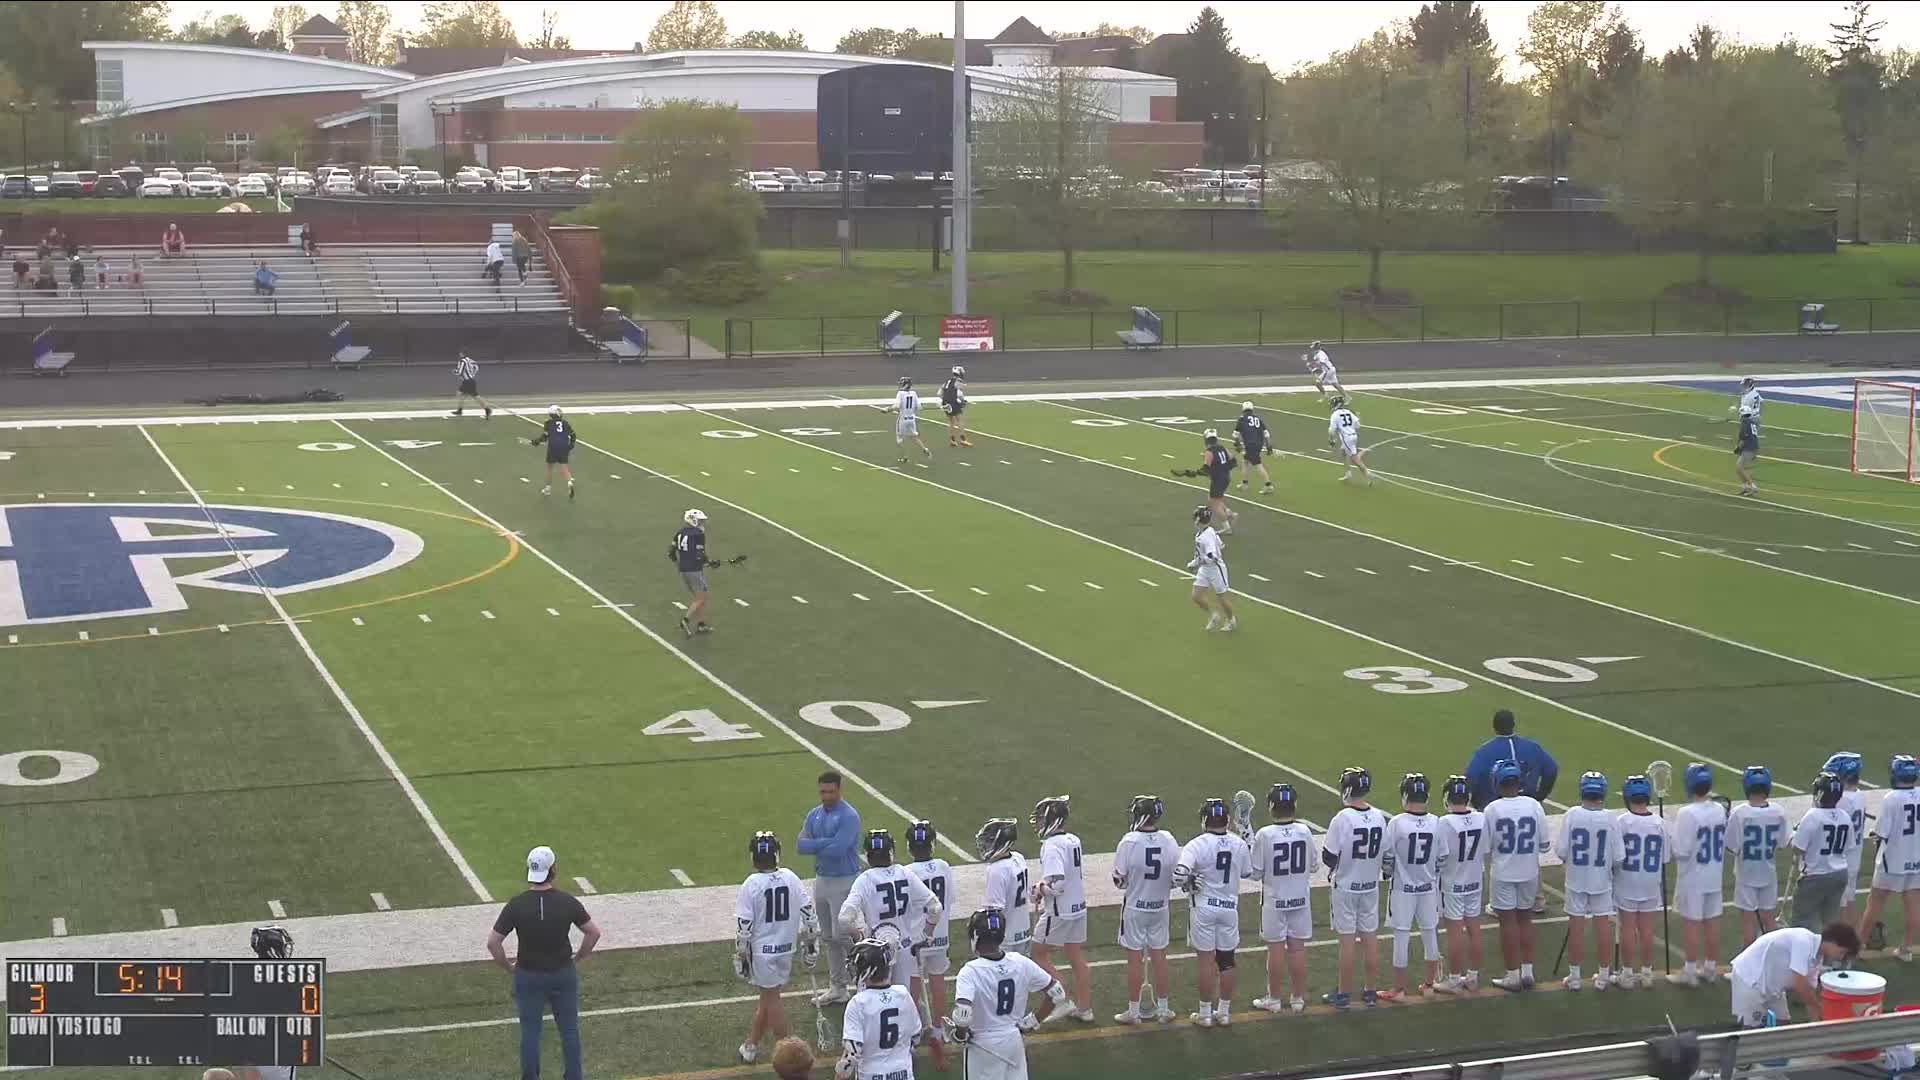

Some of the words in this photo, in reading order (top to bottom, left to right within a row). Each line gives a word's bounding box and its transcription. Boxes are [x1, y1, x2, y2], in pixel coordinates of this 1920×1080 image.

[906, 396, 913, 409] 11
[555, 421, 563, 433] 3
[1247, 415, 1260, 428] 30
[1340, 413, 1352, 427] 33
[677, 534, 688, 551] 14
[1352, 827, 1382, 859] 28
[1407, 832, 1433, 864] 13
[1458, 829, 1482, 862] 17
[1496, 817, 1536, 854] 32
[1571, 828, 1607, 867] 21
[1820, 824, 1849, 855] 30
[1144, 847, 1162, 880] 5
[1216, 851, 1232, 884] 9
[1273, 841, 1306, 876] 20
[1622, 833, 1662, 872] 28
[764, 886, 790, 923] 10
[876, 879, 909, 920] 35
[997, 979, 1015, 1016] 8
[879, 1008, 899, 1049] 6
